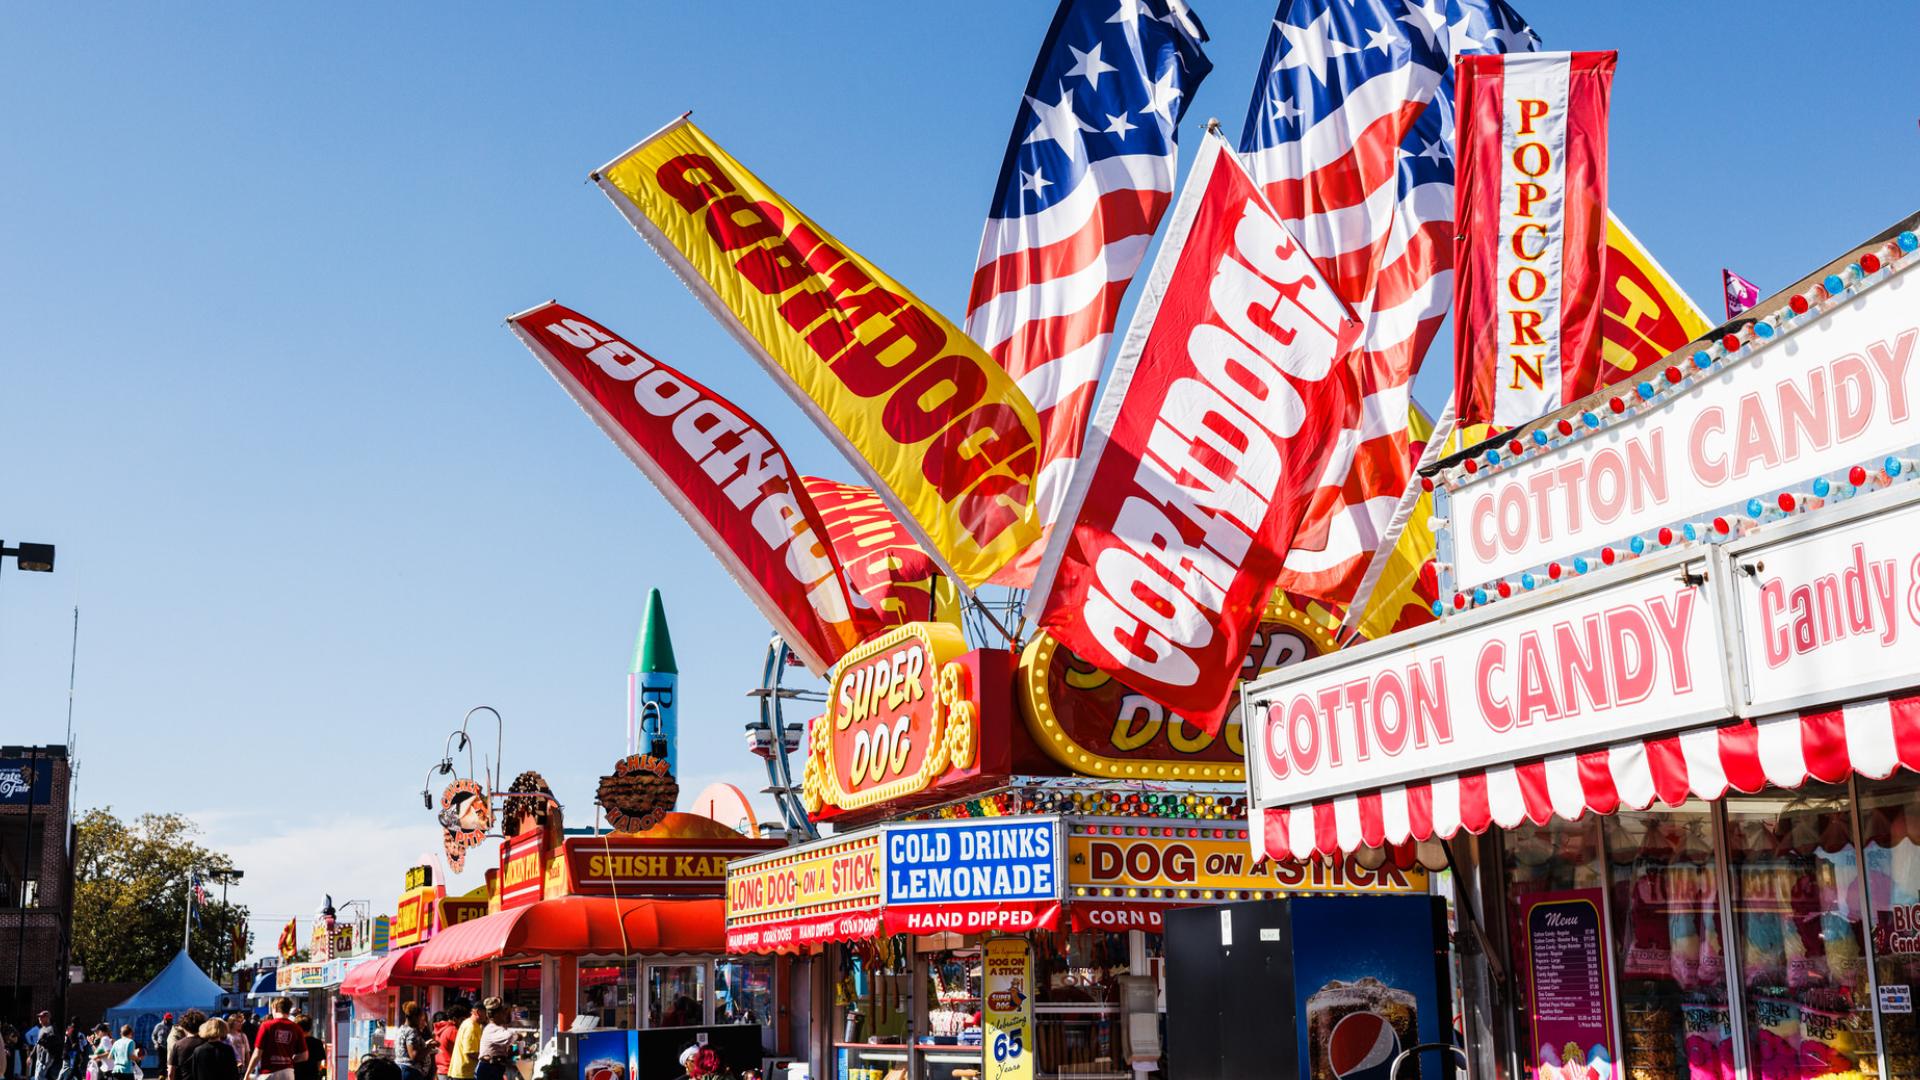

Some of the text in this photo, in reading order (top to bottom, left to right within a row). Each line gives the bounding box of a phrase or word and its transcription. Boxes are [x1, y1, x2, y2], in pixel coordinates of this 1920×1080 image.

[1508, 98, 1551, 391] POPCORN
[1471, 327, 1918, 563] COTTON CANDY
[1759, 542, 1898, 669] Candy
[837, 645, 925, 730] SUPER
[1262, 655, 1454, 780] COTTON
[1476, 586, 1697, 733] CANDY
[852, 715, 911, 786] DOG
[0, 772, 21, 780] tate
[615, 753, 671, 778] SHISH
[0, 779, 31, 798] Fair
[455, 829, 486, 849] PITA
[891, 827, 1050, 864] COLD DRINKS
[589, 855, 740, 878] SHISH KAB
[1090, 842, 1196, 883] DOG
[1205, 853, 1243, 875] ON
[1250, 858, 1268, 876] A
[732, 851, 876, 912] LONG DOG ON A STICK
[892, 863, 1051, 900] LEMONADE
[907, 910, 1033, 928] HAND DIPPED
[1089, 909, 1145, 926] CORN
[1545, 912, 1578, 926] Menu
[778, 926, 792, 942] DOGS
[799, 924, 815, 938] HAND
[816, 922, 834, 937] DIPPED
[840, 919, 858, 934] CORN
[1890, 931, 1920, 954] Cand
[988, 958, 1025, 966] DOG ON
[990, 967, 1024, 976] A STICK
[988, 1016, 1027, 1034] Celebrating
[994, 1028, 1022, 1062] 65
[996, 1063, 1020, 1080] Years
